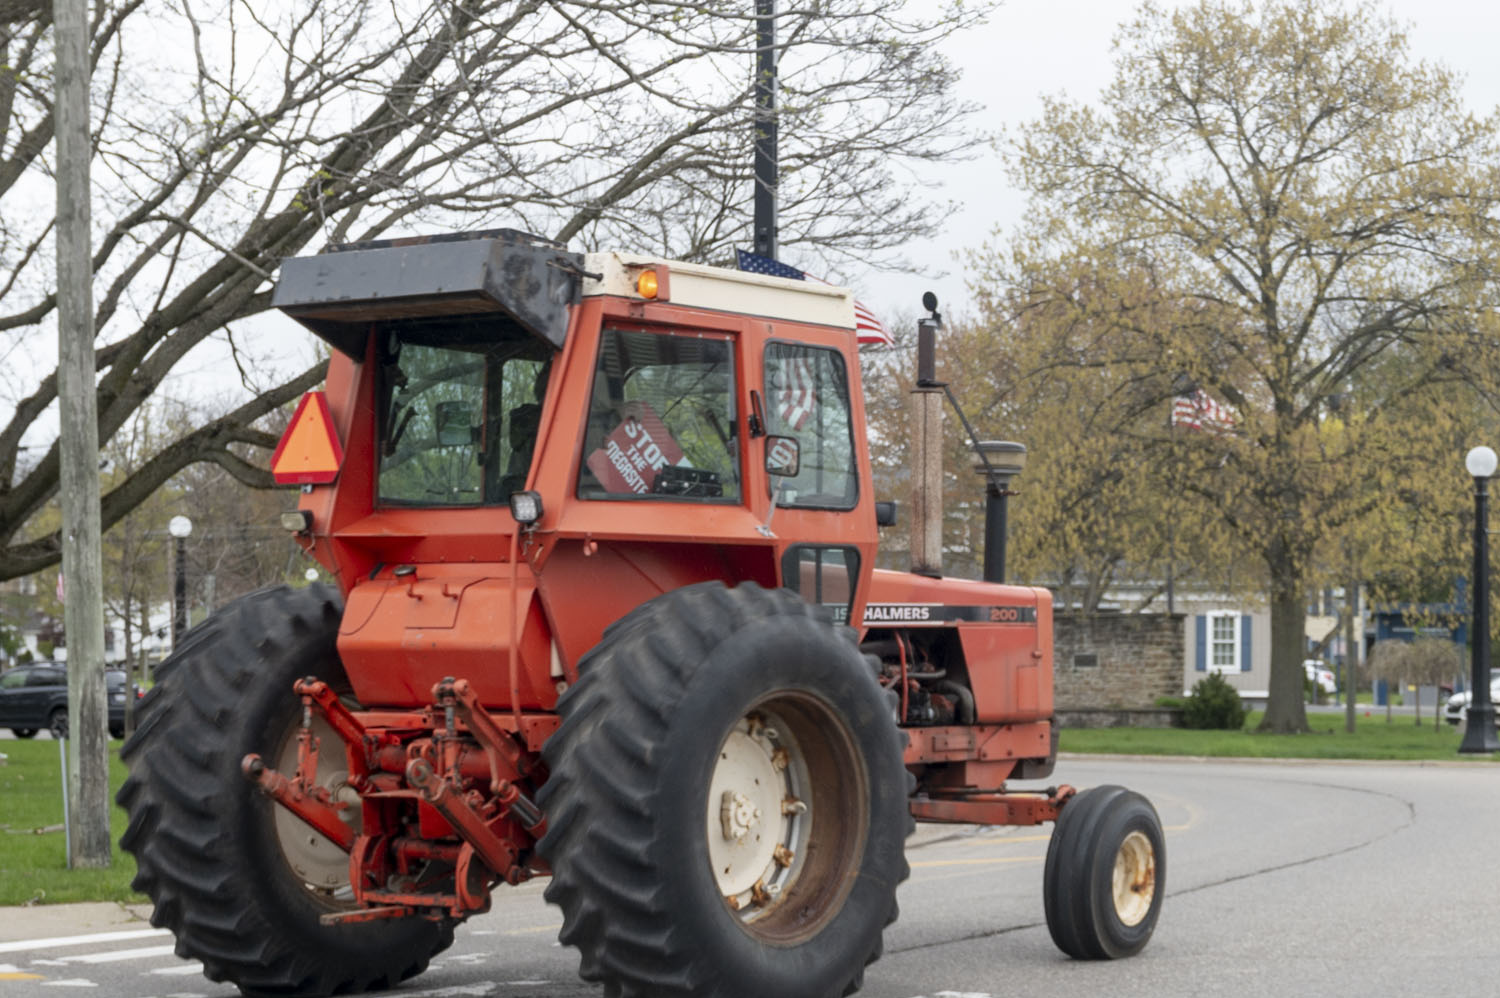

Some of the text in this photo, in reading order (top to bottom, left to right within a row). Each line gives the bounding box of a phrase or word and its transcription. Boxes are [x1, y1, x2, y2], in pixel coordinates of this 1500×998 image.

[628, 445, 647, 471] THE
[864, 607, 930, 620] HALMERS
[991, 608, 1017, 621] 200
